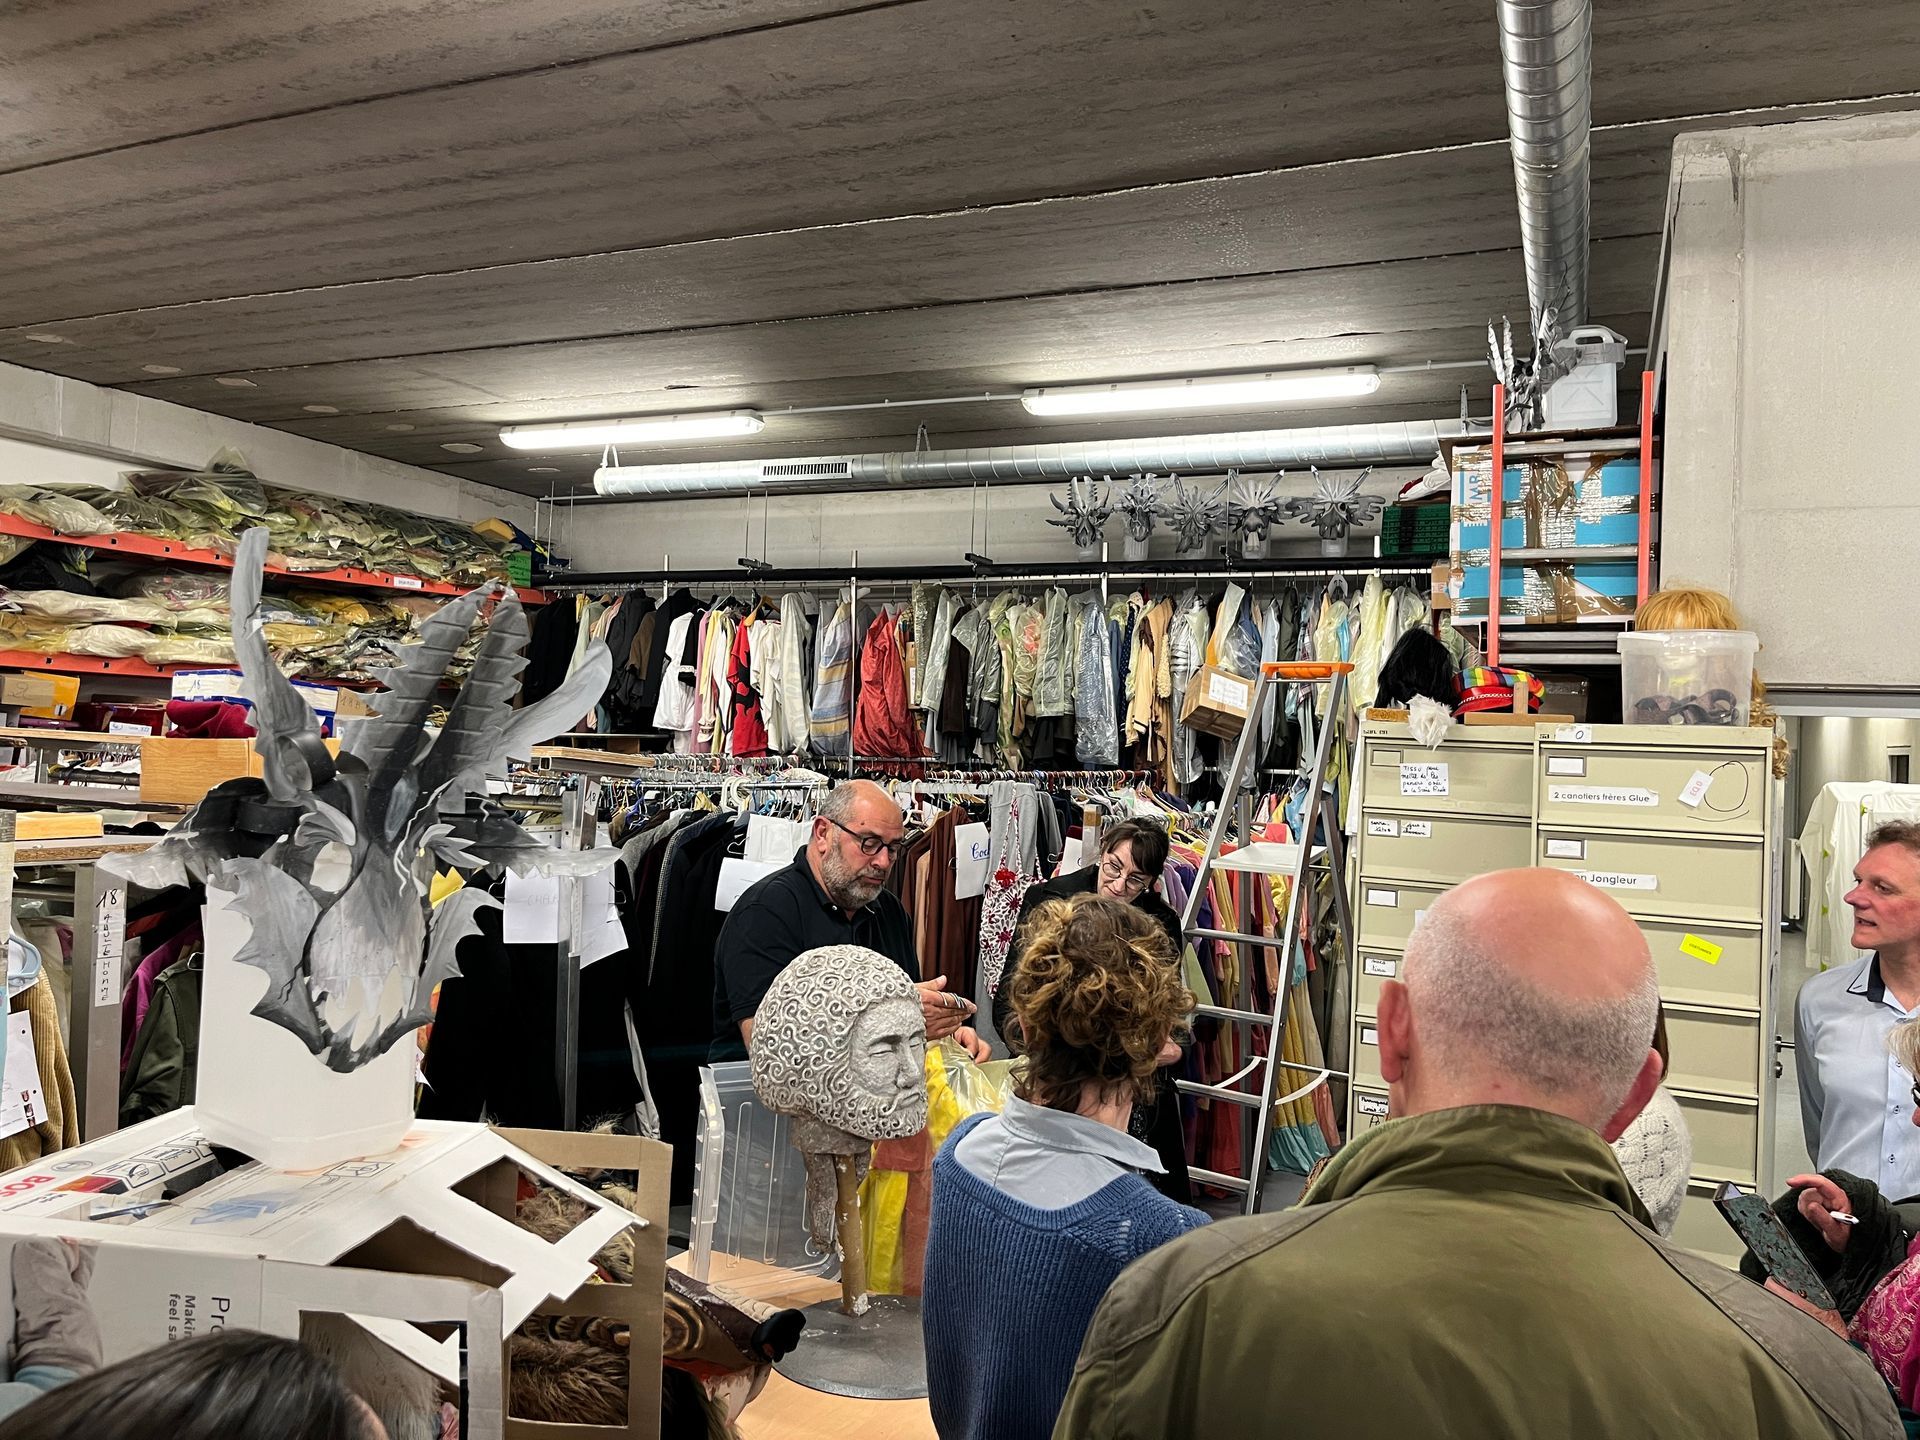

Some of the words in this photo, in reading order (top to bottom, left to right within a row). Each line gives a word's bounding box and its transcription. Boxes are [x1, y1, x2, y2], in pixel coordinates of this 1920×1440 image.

[1554, 791, 1559, 799] 2
[1561, 792, 1600, 801] canotiers
[1602, 792, 1627, 802] frères
[1629, 794, 1650, 803] Glue
[1590, 874, 1637, 886] Jongleur
[96, 888, 118, 908] 18
[169, 1293, 181, 1321] feel
